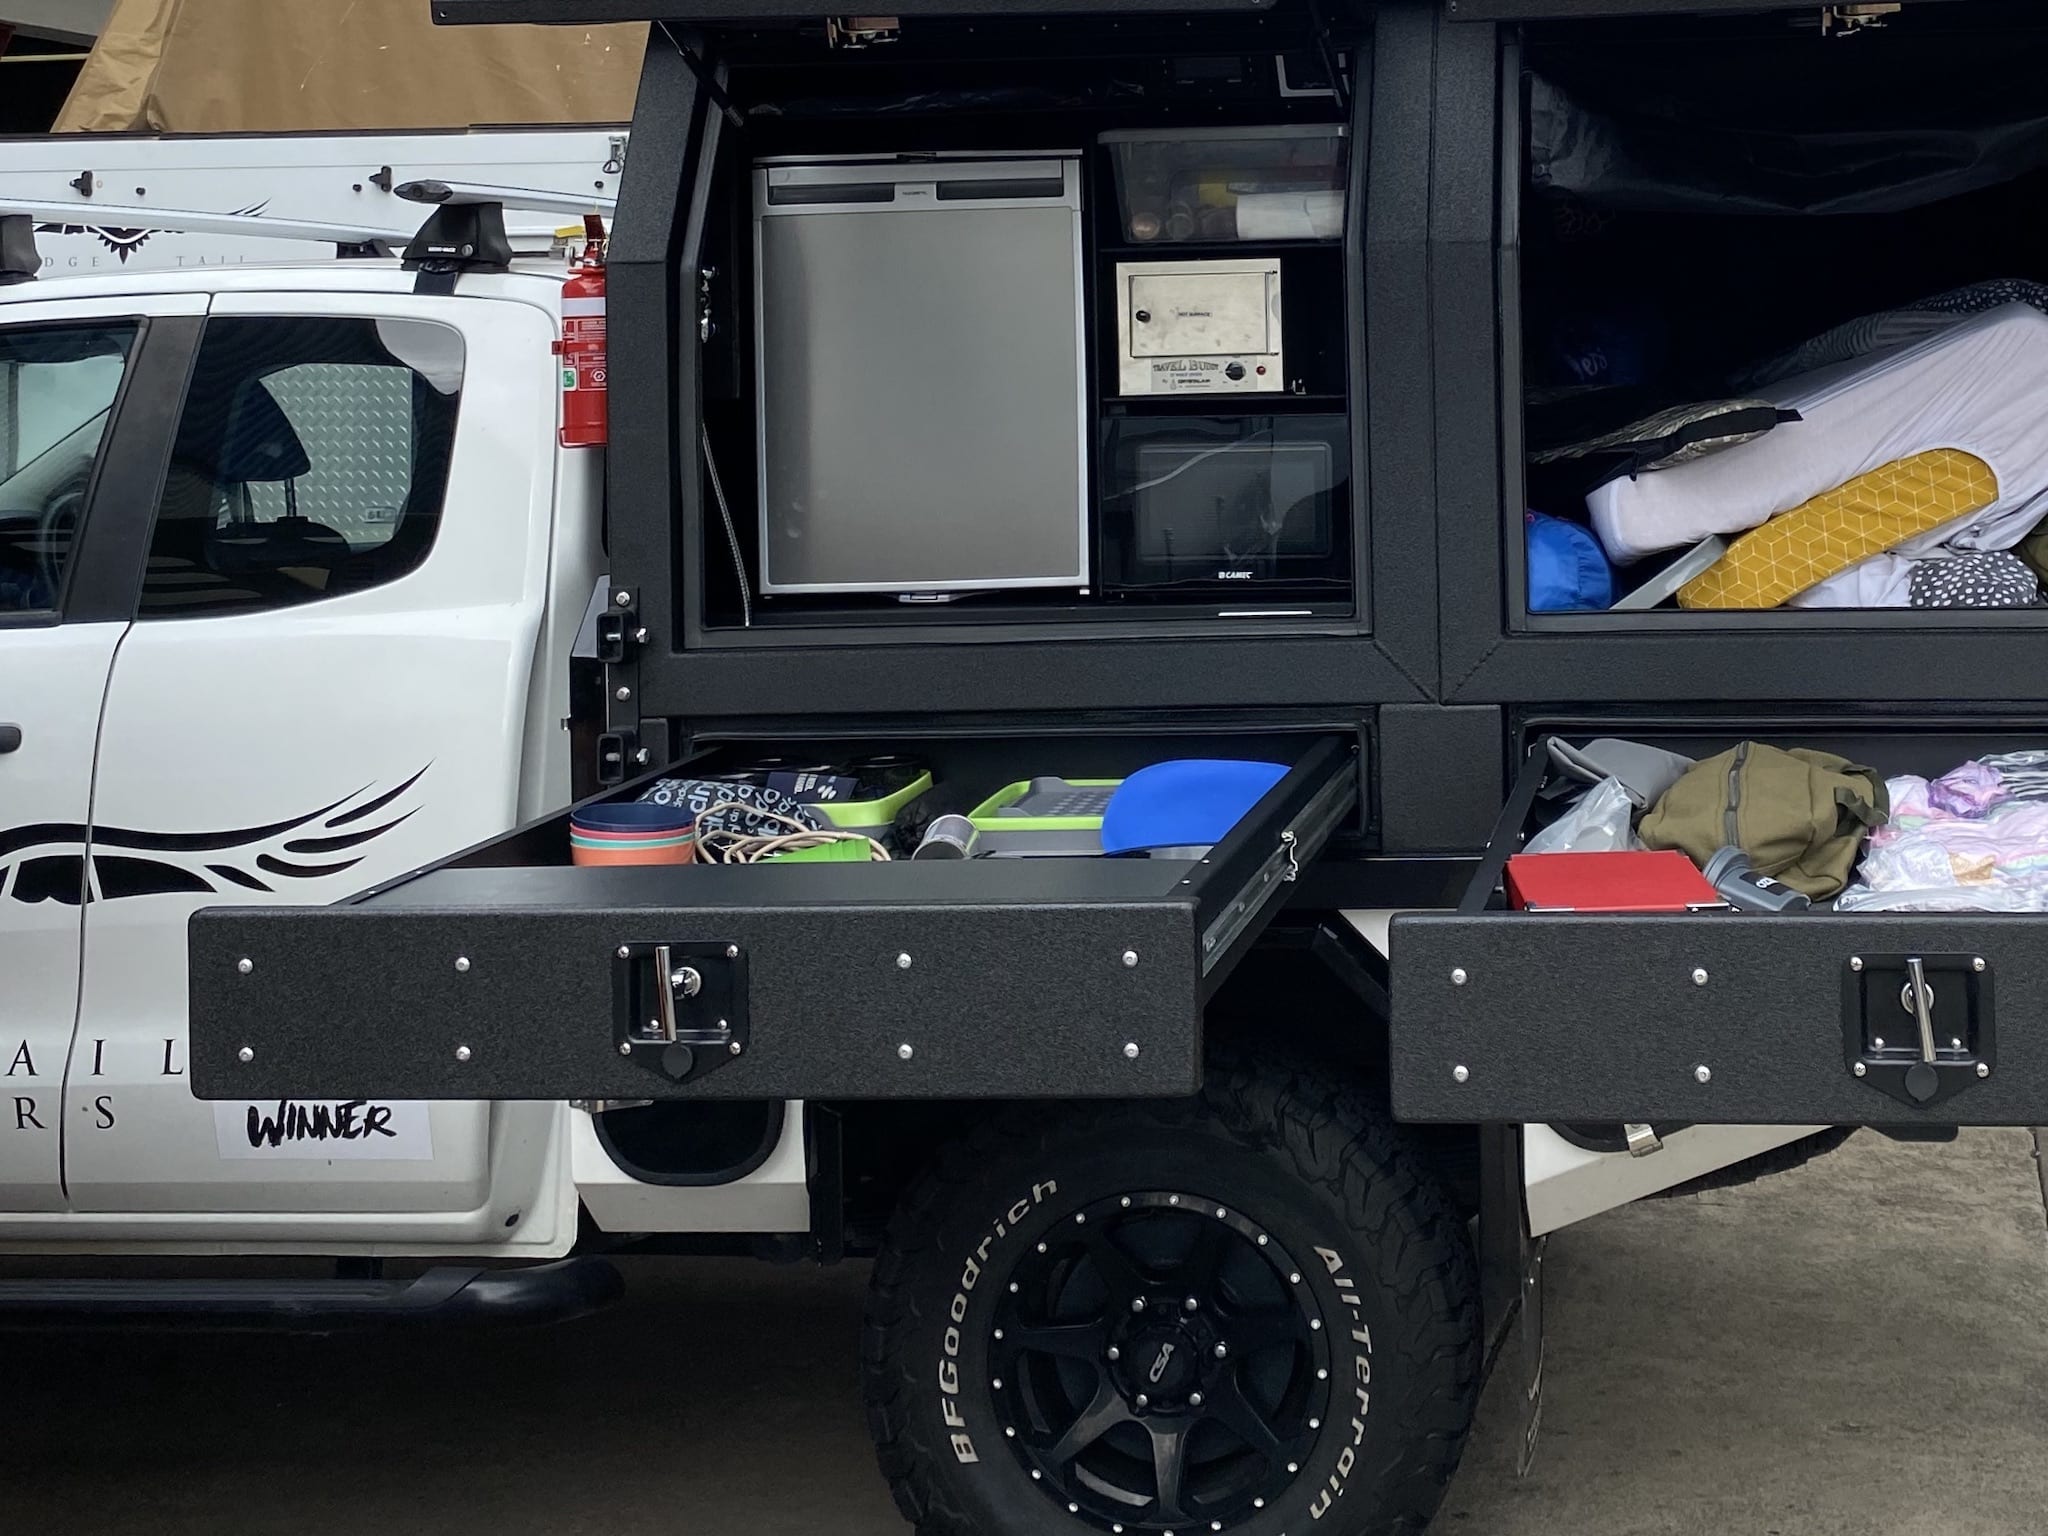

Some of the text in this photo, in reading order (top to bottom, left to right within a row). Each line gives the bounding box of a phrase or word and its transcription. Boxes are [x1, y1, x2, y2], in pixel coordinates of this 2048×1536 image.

[247, 1098, 397, 1148] WINNER
[938, 1178, 1058, 1464] BFGoodrich
[1309, 1246, 1373, 1520] All-Terrain
